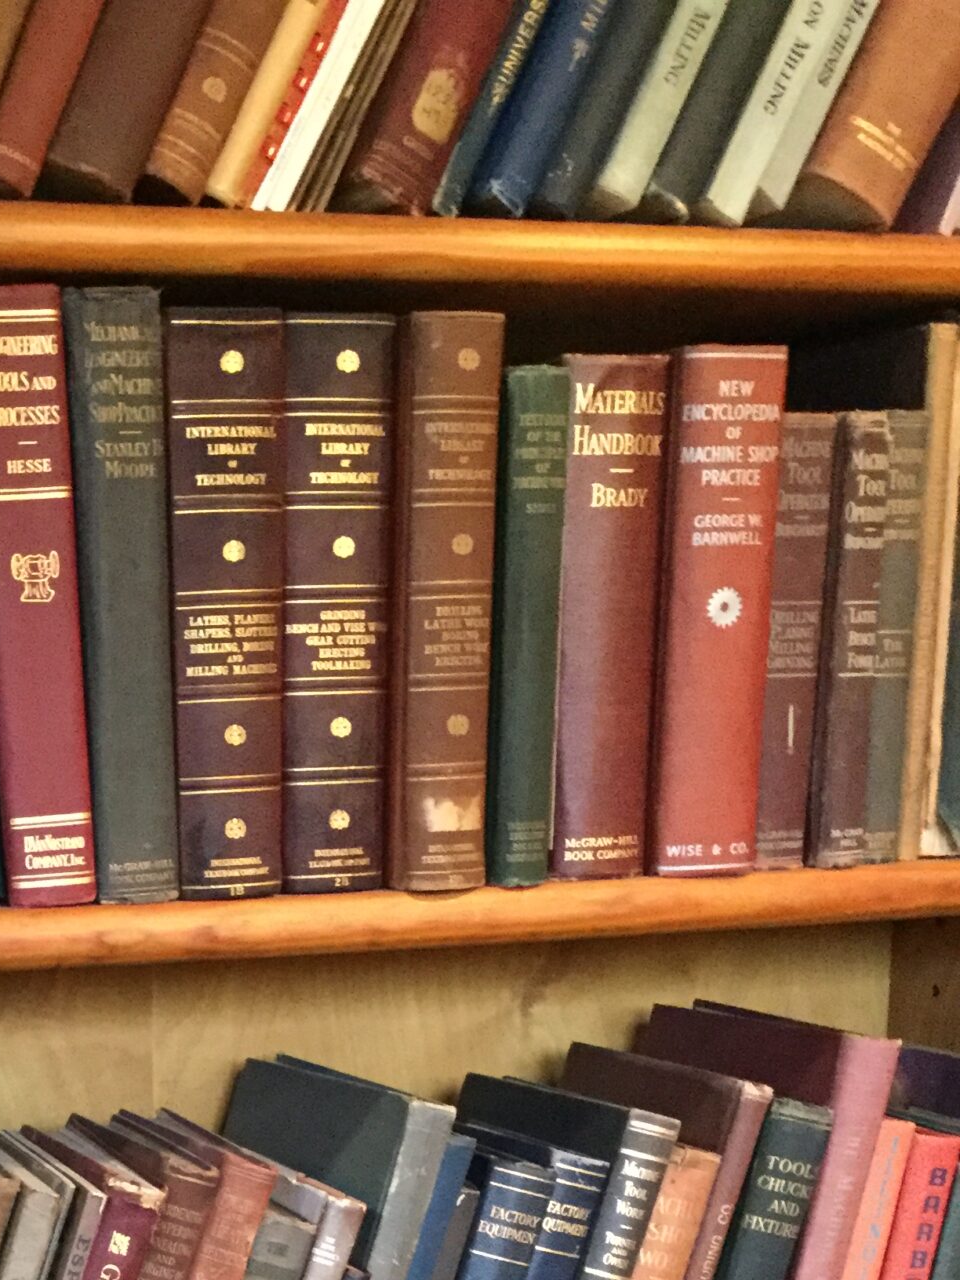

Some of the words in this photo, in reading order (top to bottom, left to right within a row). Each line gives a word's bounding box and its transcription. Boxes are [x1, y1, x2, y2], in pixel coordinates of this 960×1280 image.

[762, 36, 811, 117] MILLING
[31, 375, 57, 391] AND
[718, 380, 755, 397] NEW
[573, 382, 667, 417] MATERIALS
[681, 403, 781, 422] ENCYCLOPEDIA
[185, 425, 277, 439] INTERNATIONAL
[305, 423, 385, 437] INTERNATIONAL
[725, 426, 742, 441] OF
[207, 442, 258, 456] LIBRARY
[321, 442, 370, 456] LIBRARY
[572, 425, 664, 458] HANDBOOK
[680, 446, 744, 464] MACHINE
[746, 445, 780, 463] SHOP
[6, 458, 52, 474] HESSE
[195, 473, 268, 486] TECHNOLOGY
[309, 471, 380, 485] TECHNOLOGY
[701, 469, 761, 488] PRACTICE
[590, 483, 648, 509] BRADY
[693, 513, 742, 529] GEORGE
[691, 530, 762, 547] BARNWELL
[563, 848, 595, 862] BOOK
[597, 847, 640, 862] COMPANY
[666, 843, 704, 858] WISE
[546, 1200, 591, 1221] FACTORY
[770, 1199, 800, 1218] AND
[490, 1205, 540, 1229] FACTORY
